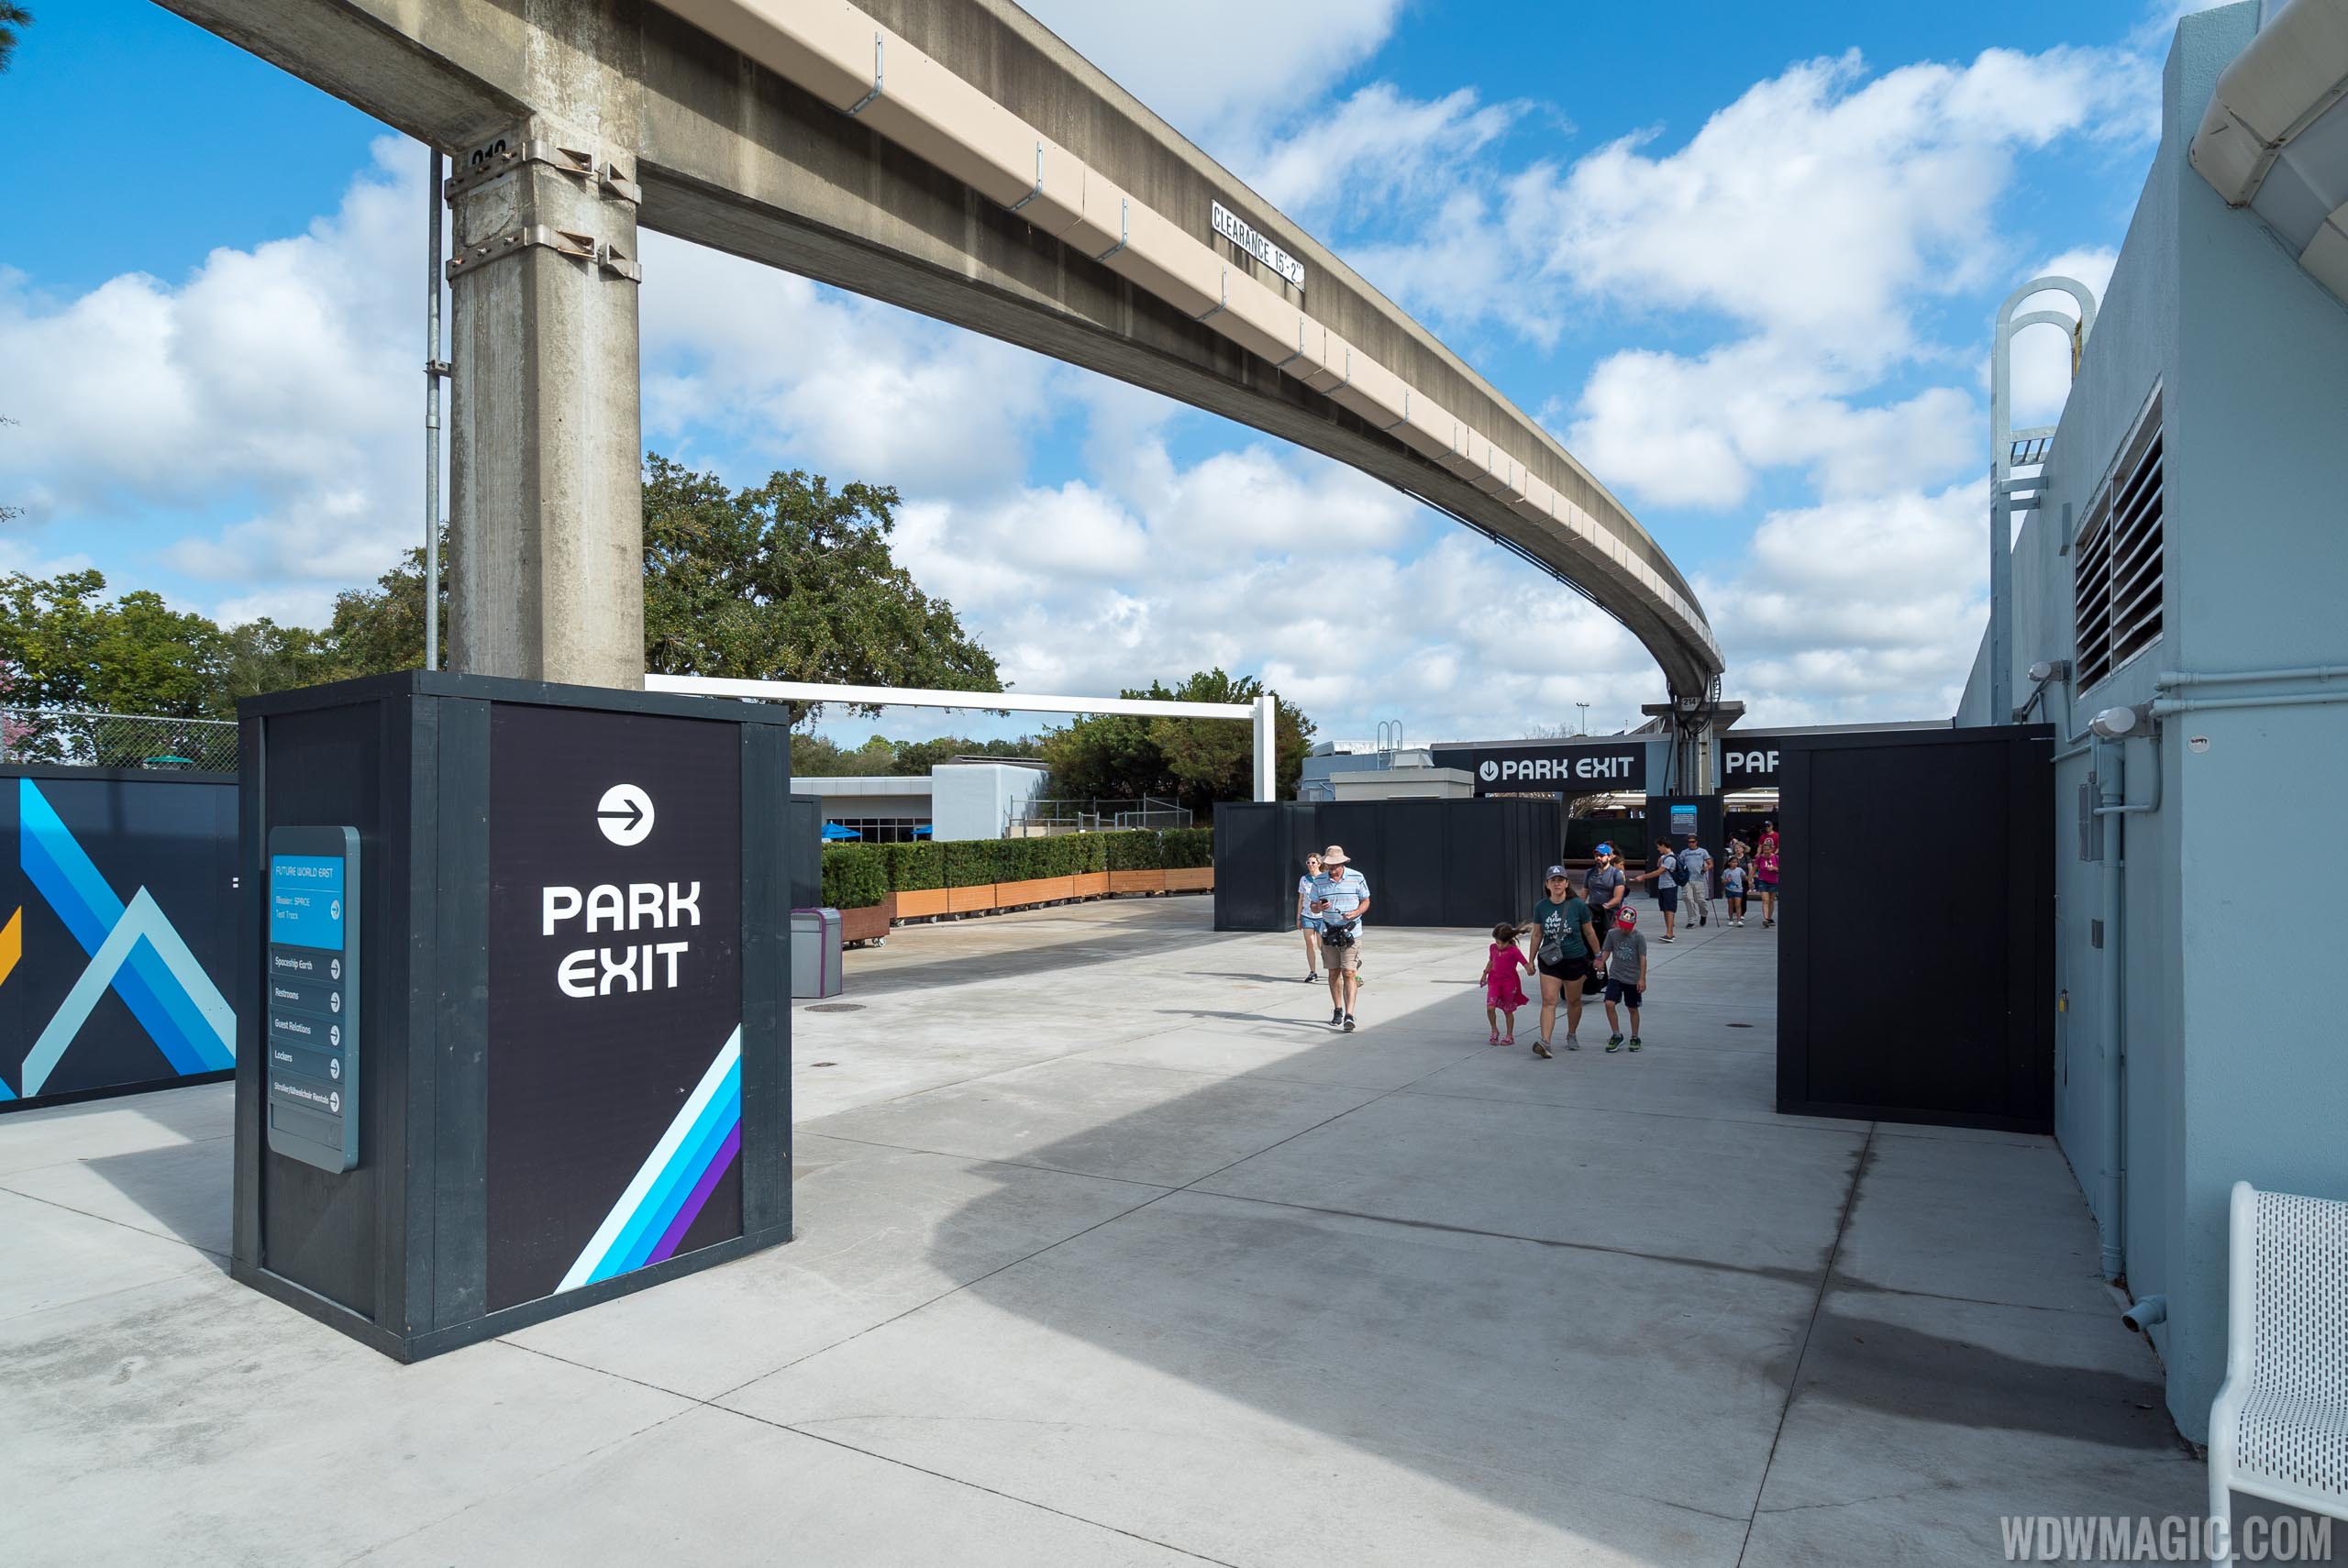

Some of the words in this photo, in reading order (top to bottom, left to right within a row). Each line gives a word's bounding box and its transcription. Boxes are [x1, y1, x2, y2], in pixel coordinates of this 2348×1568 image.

[1213, 205, 1269, 264] CLEARANCE
[1502, 758, 1568, 780] PARK
[1576, 756, 1634, 778] EXIT
[275, 866, 296, 877] FUTURE
[297, 867, 317, 878] WORLD
[318, 867, 334, 878] EAST
[294, 897, 310, 907] SPACE
[543, 881, 701, 936] PARK
[275, 956, 298, 970] Spaceship
[299, 959, 313, 970] Earth
[558, 941, 688, 999] EXIT
[275, 988, 299, 1000] Restrooms
[274, 1019, 289, 1030] Guest
[289, 1021, 311, 1034] Relations
[274, 1050, 293, 1063] Lockers
[313, 1092, 329, 1105] Rentals
